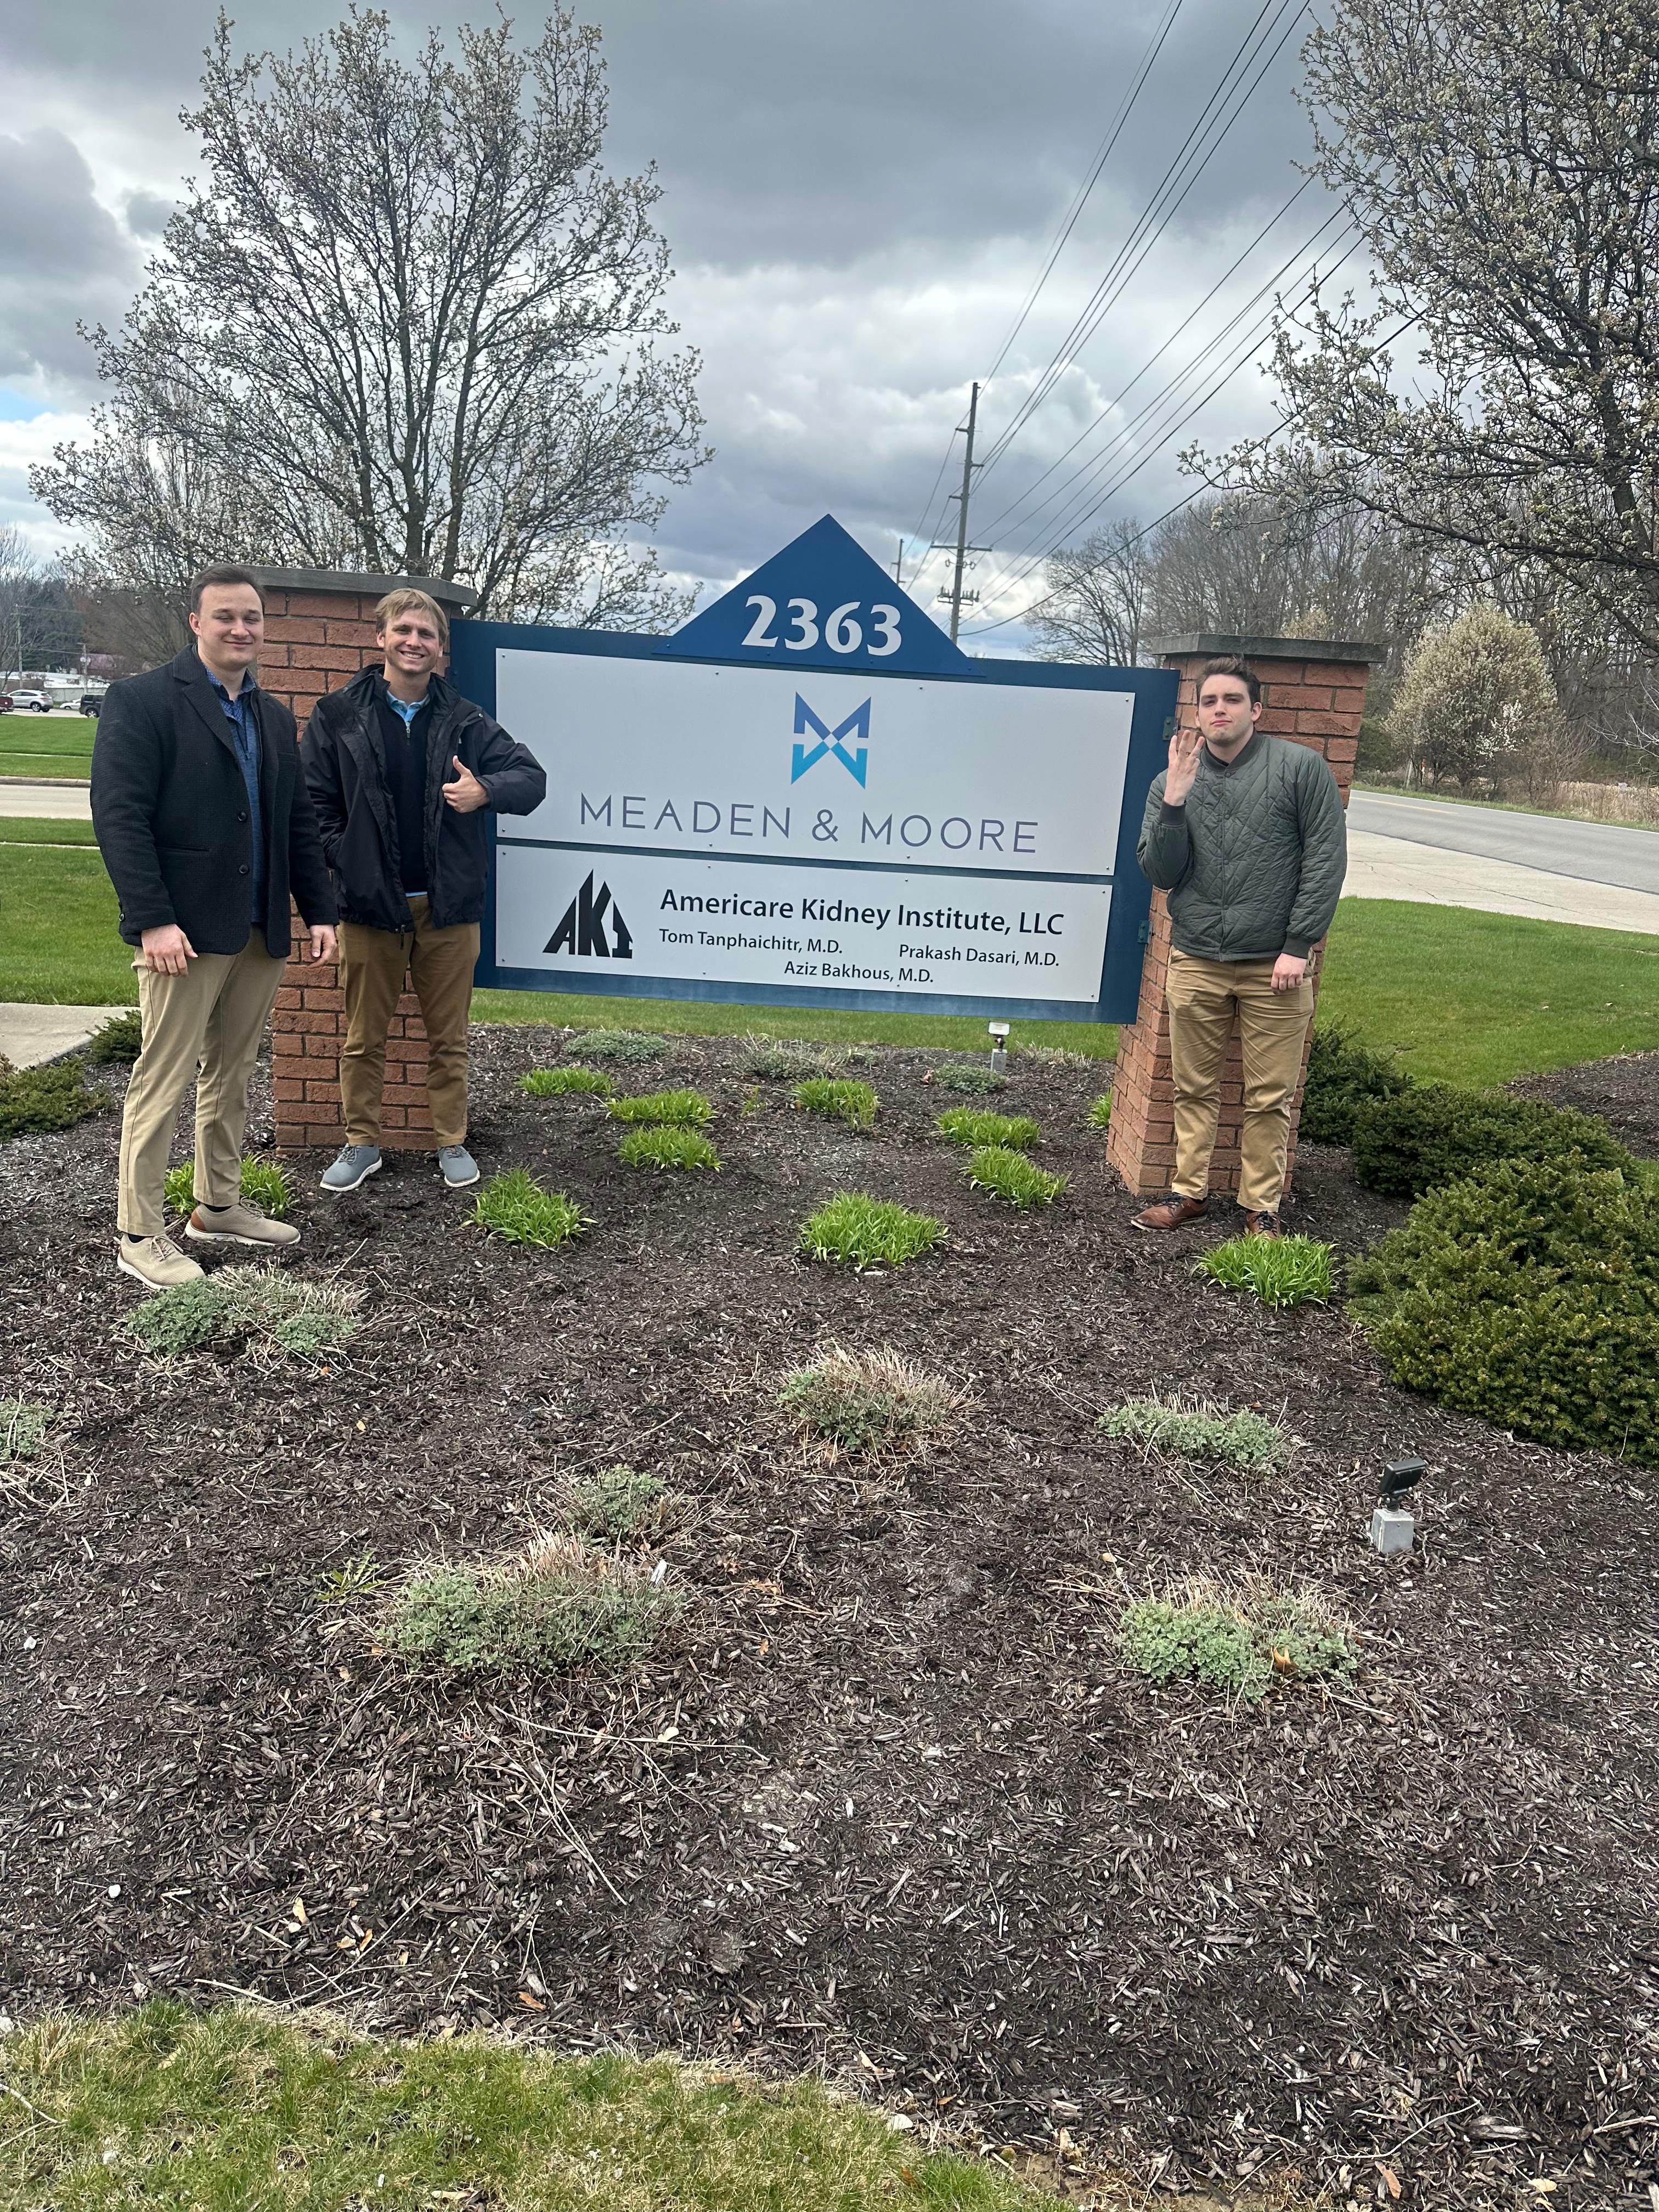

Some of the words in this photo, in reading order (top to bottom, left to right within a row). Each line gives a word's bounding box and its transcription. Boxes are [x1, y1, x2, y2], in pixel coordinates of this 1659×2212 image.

[742, 595, 901, 656] 2363
[581, 793, 790, 838] MEADEN
[812, 809, 838, 842] &
[861, 812, 1037, 854] MOORE
[660, 889, 793, 918] Americare
[802, 899, 891, 930] Kidney
[898, 905, 1011, 935] Institute,
[1019, 912, 1064, 934] LLC
[659, 929, 693, 944] Tom
[698, 932, 802, 953] Tanphaichitr,
[808, 939, 842, 953] M.D.
[900, 945, 961, 960] Prakash
[967, 949, 1019, 966] Dasari,
[1025, 952, 1059, 966] M.D.
[784, 961, 817, 975] Aziz
[822, 963, 893, 982] Bakhous,
[899, 968, 933, 982] M.D.
